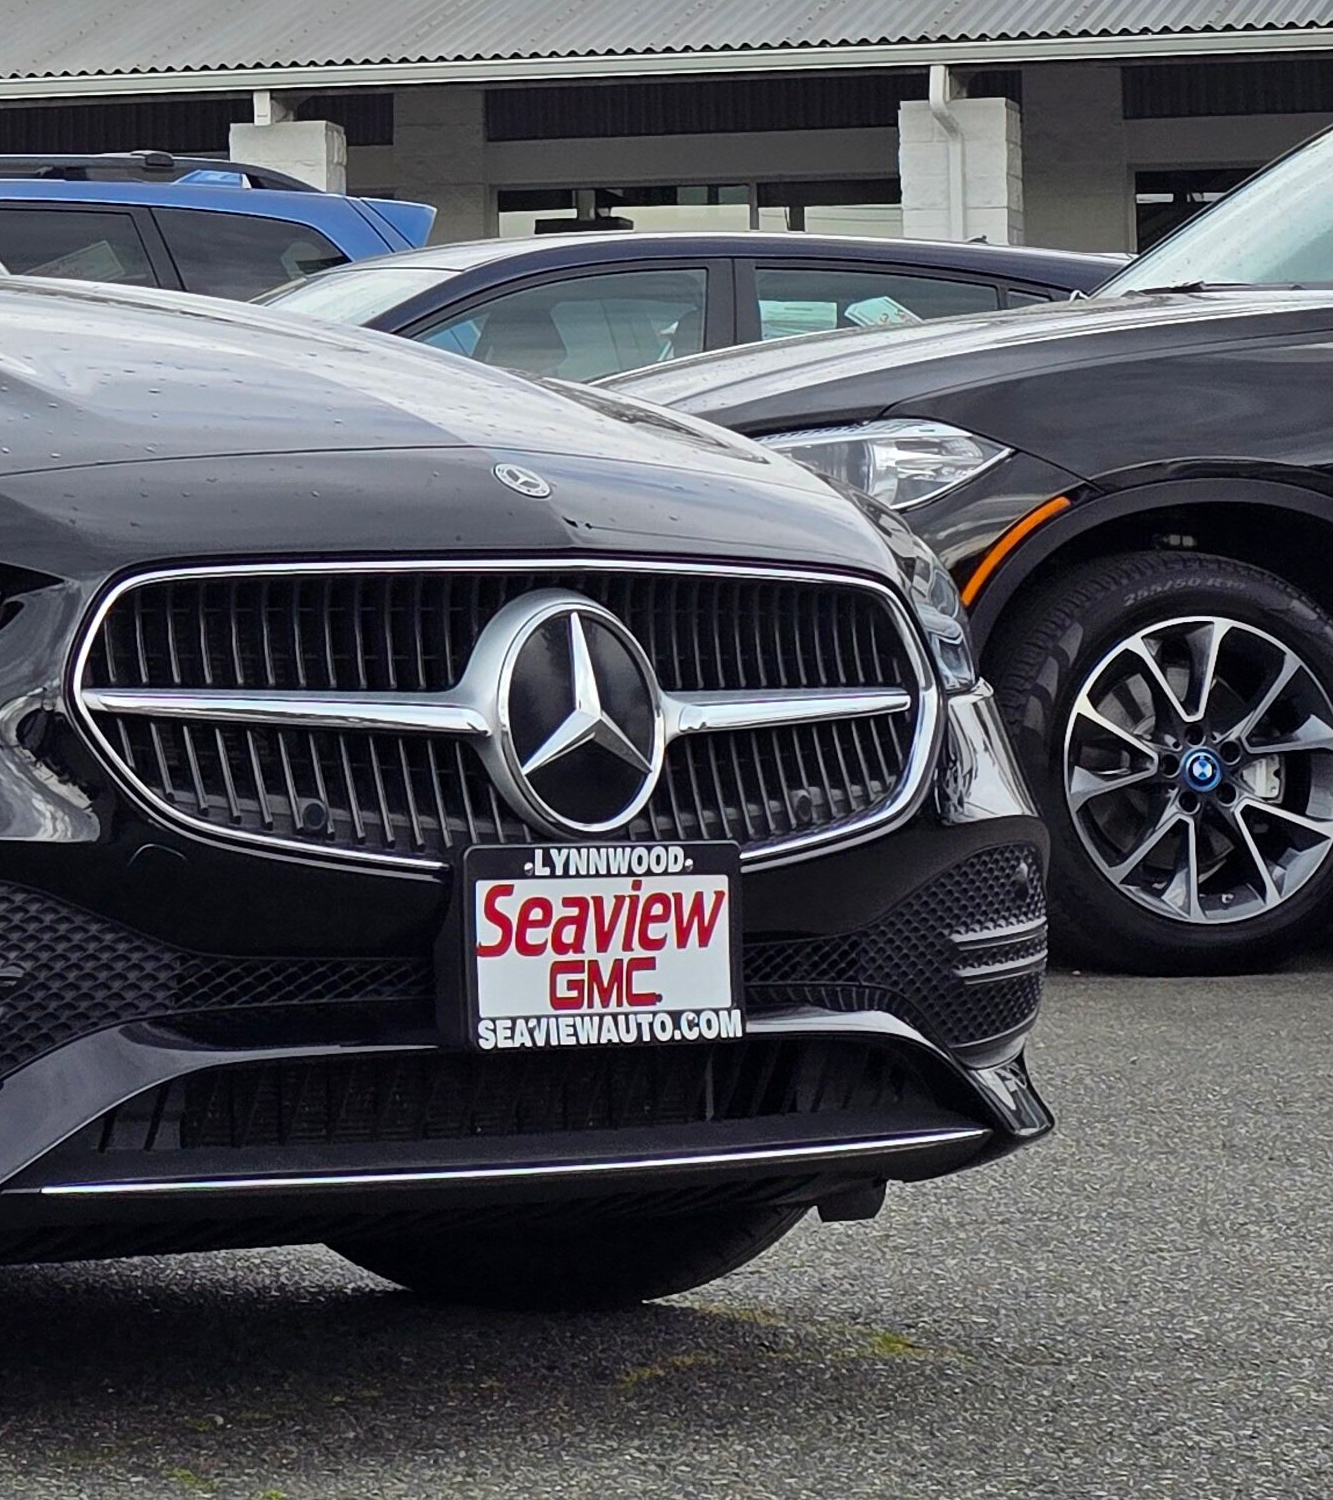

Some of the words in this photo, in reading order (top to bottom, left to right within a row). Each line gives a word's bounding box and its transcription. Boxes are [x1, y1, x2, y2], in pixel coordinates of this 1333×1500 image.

[535, 846, 685, 876] LYNNWOOD
[476, 880, 727, 957] Seaview
[549, 957, 657, 1010] GMC
[478, 1009, 744, 1049] SEAVIEWAUTO.COM
